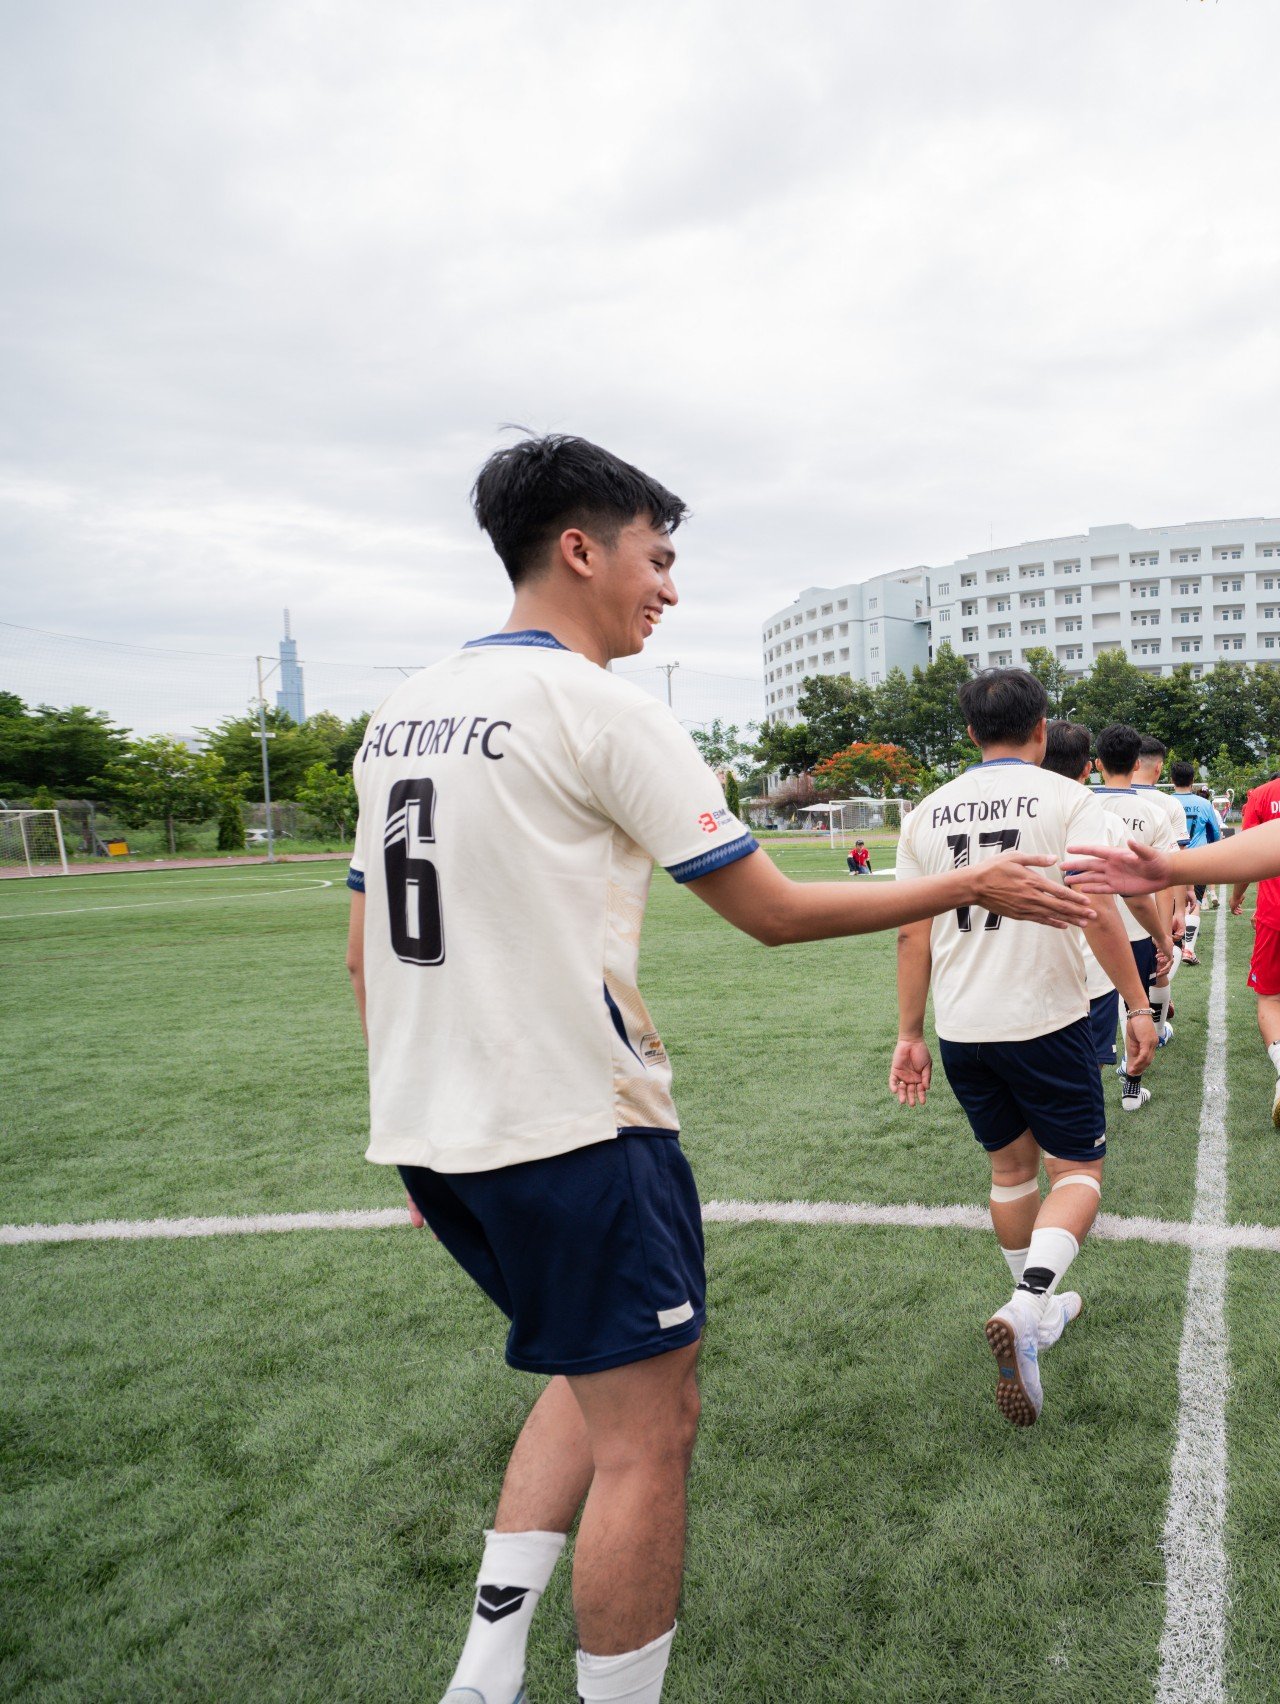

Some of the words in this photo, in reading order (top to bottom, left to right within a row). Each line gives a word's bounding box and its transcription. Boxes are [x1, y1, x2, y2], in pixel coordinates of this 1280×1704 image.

[362, 716, 466, 763] FACTORY
[463, 716, 512, 760] FC
[932, 797, 1012, 829] FACTORY
[1016, 796, 1039, 819] FC
[1132, 818, 1146, 832] FC
[384, 777, 446, 967] 6
[946, 828, 1022, 933] 17
